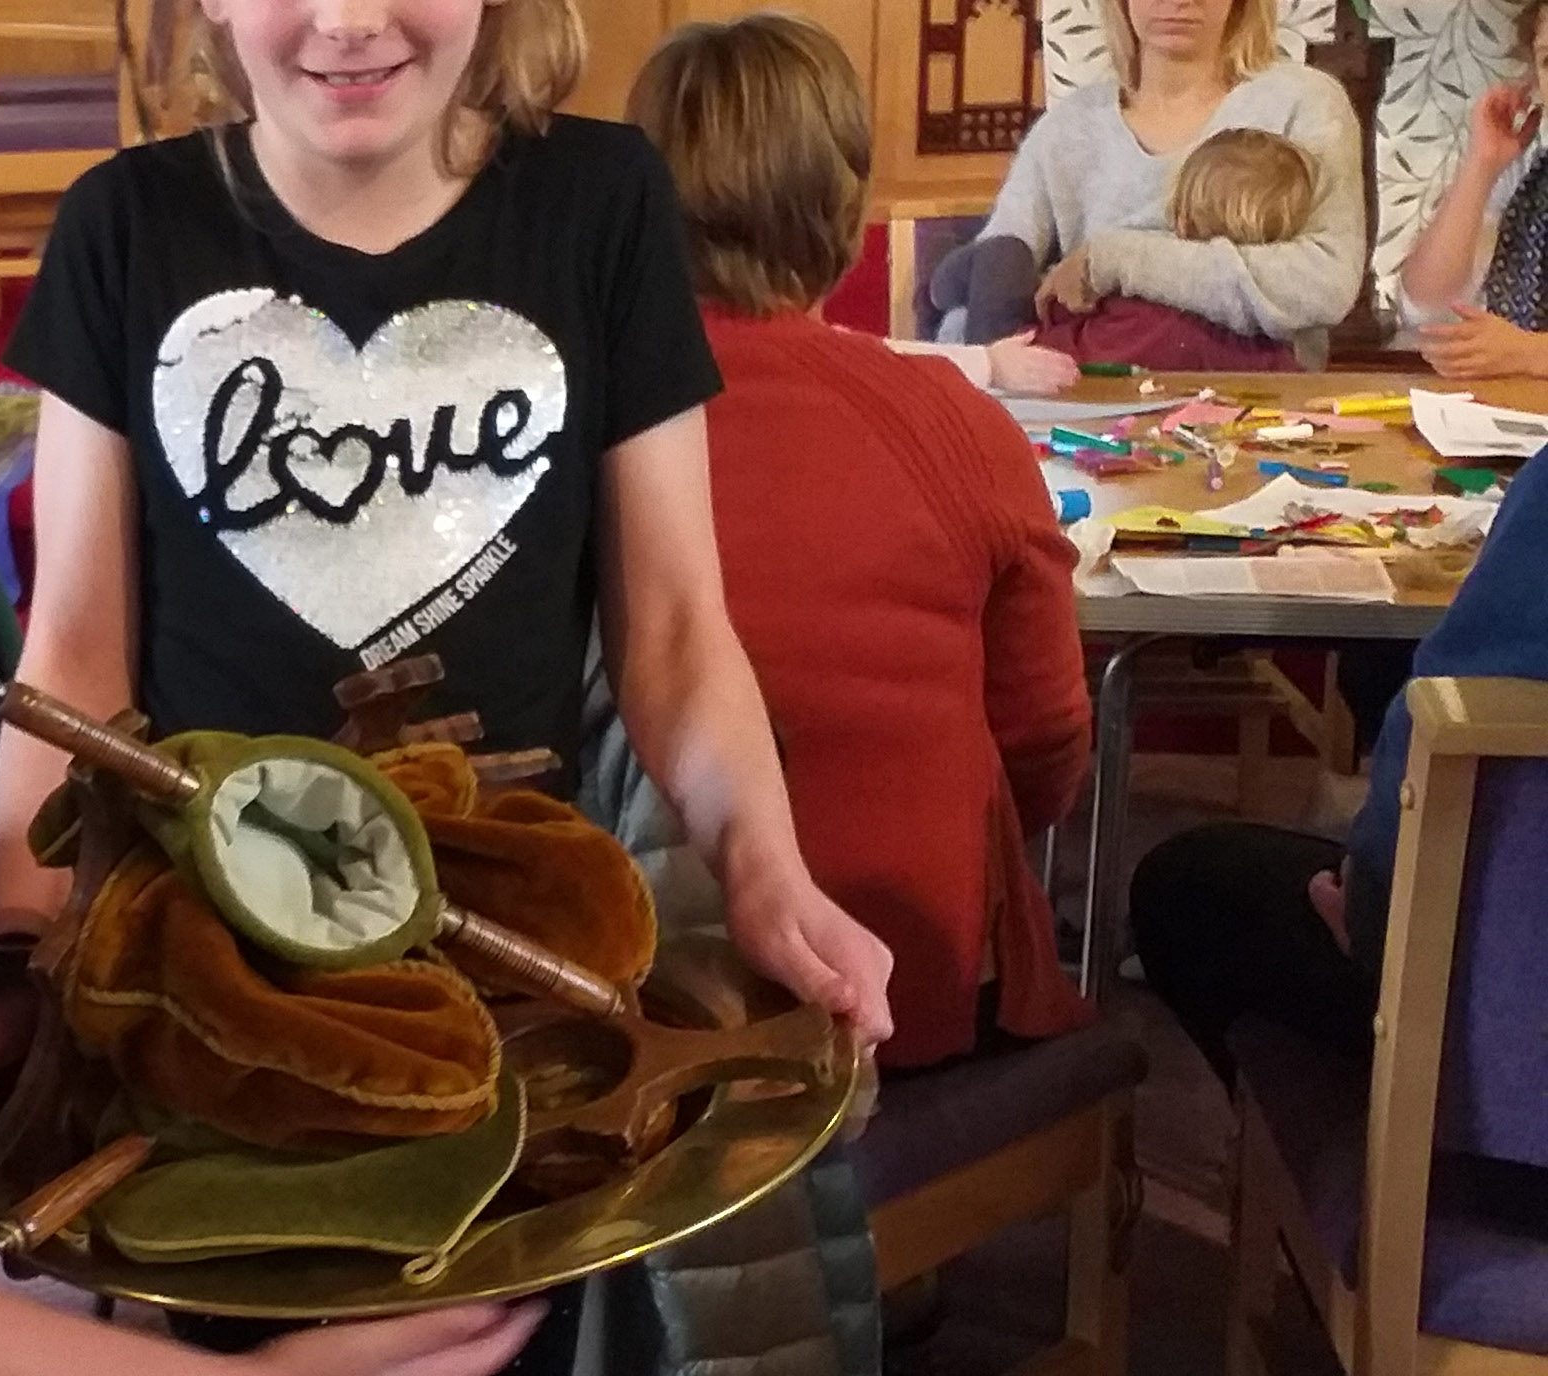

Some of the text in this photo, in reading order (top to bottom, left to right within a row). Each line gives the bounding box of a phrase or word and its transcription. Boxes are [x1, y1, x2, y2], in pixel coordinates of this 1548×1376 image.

[359, 533, 518, 671] DREAM SHINE SPARKLE
